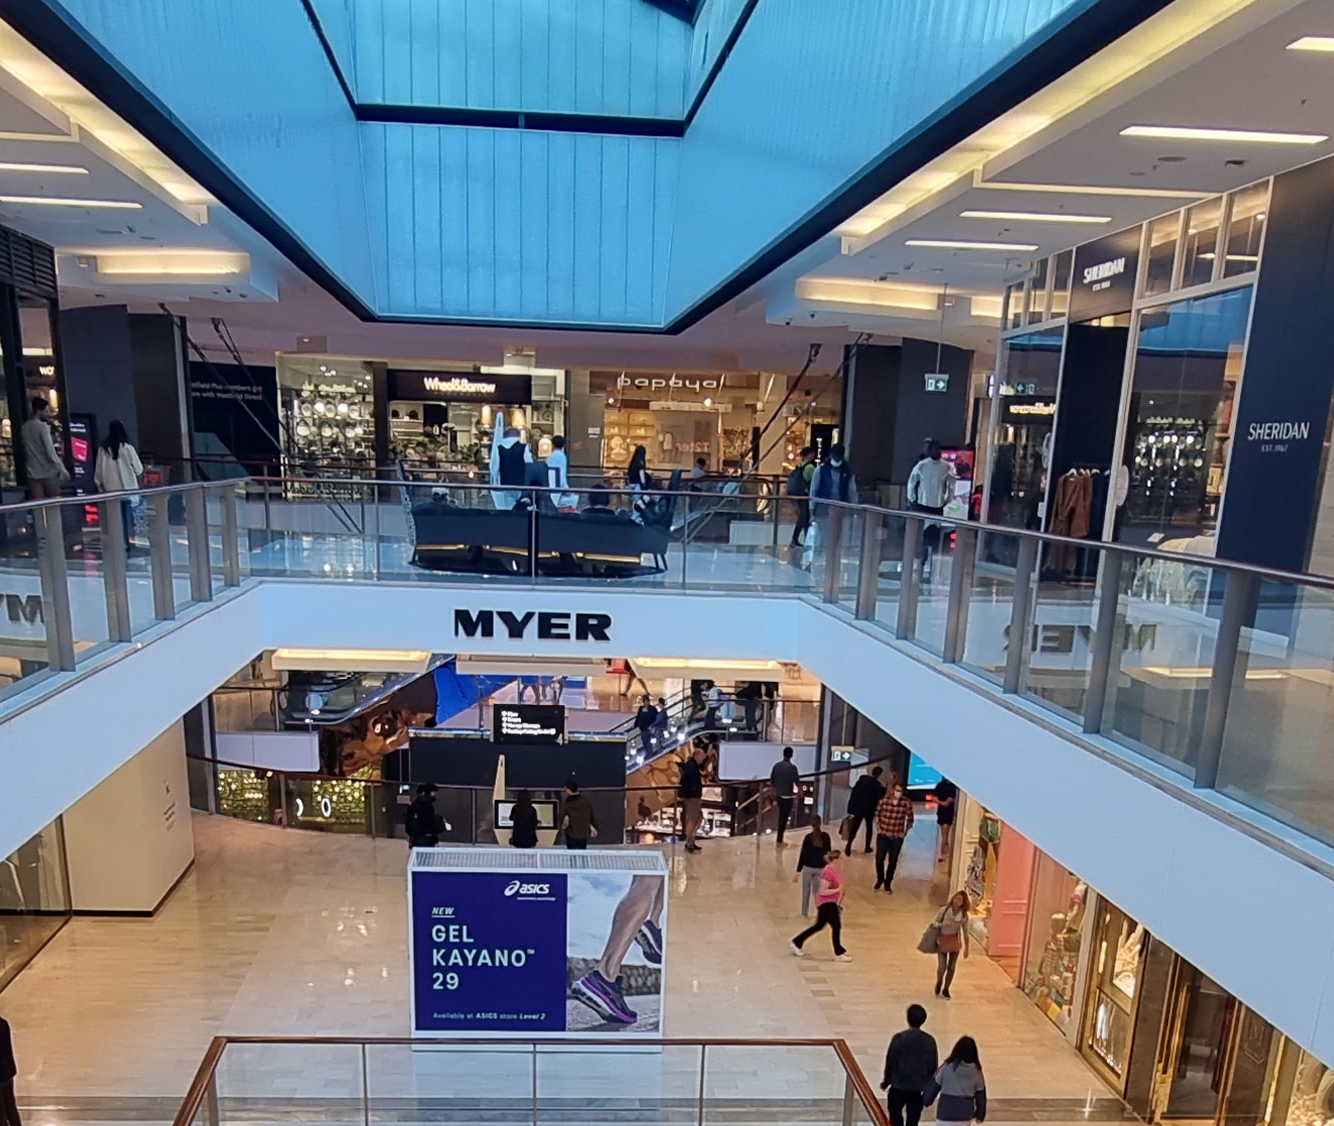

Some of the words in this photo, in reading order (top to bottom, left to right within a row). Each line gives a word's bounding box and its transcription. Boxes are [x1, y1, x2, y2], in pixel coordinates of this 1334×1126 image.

[617, 377, 717, 393] papaya
[1247, 421, 1310, 440] SHERIDAN
[454, 609, 612, 641] MYER
[432, 907, 455, 916] NEW
[431, 924, 475, 943] GEL
[432, 972, 460, 990] 29
